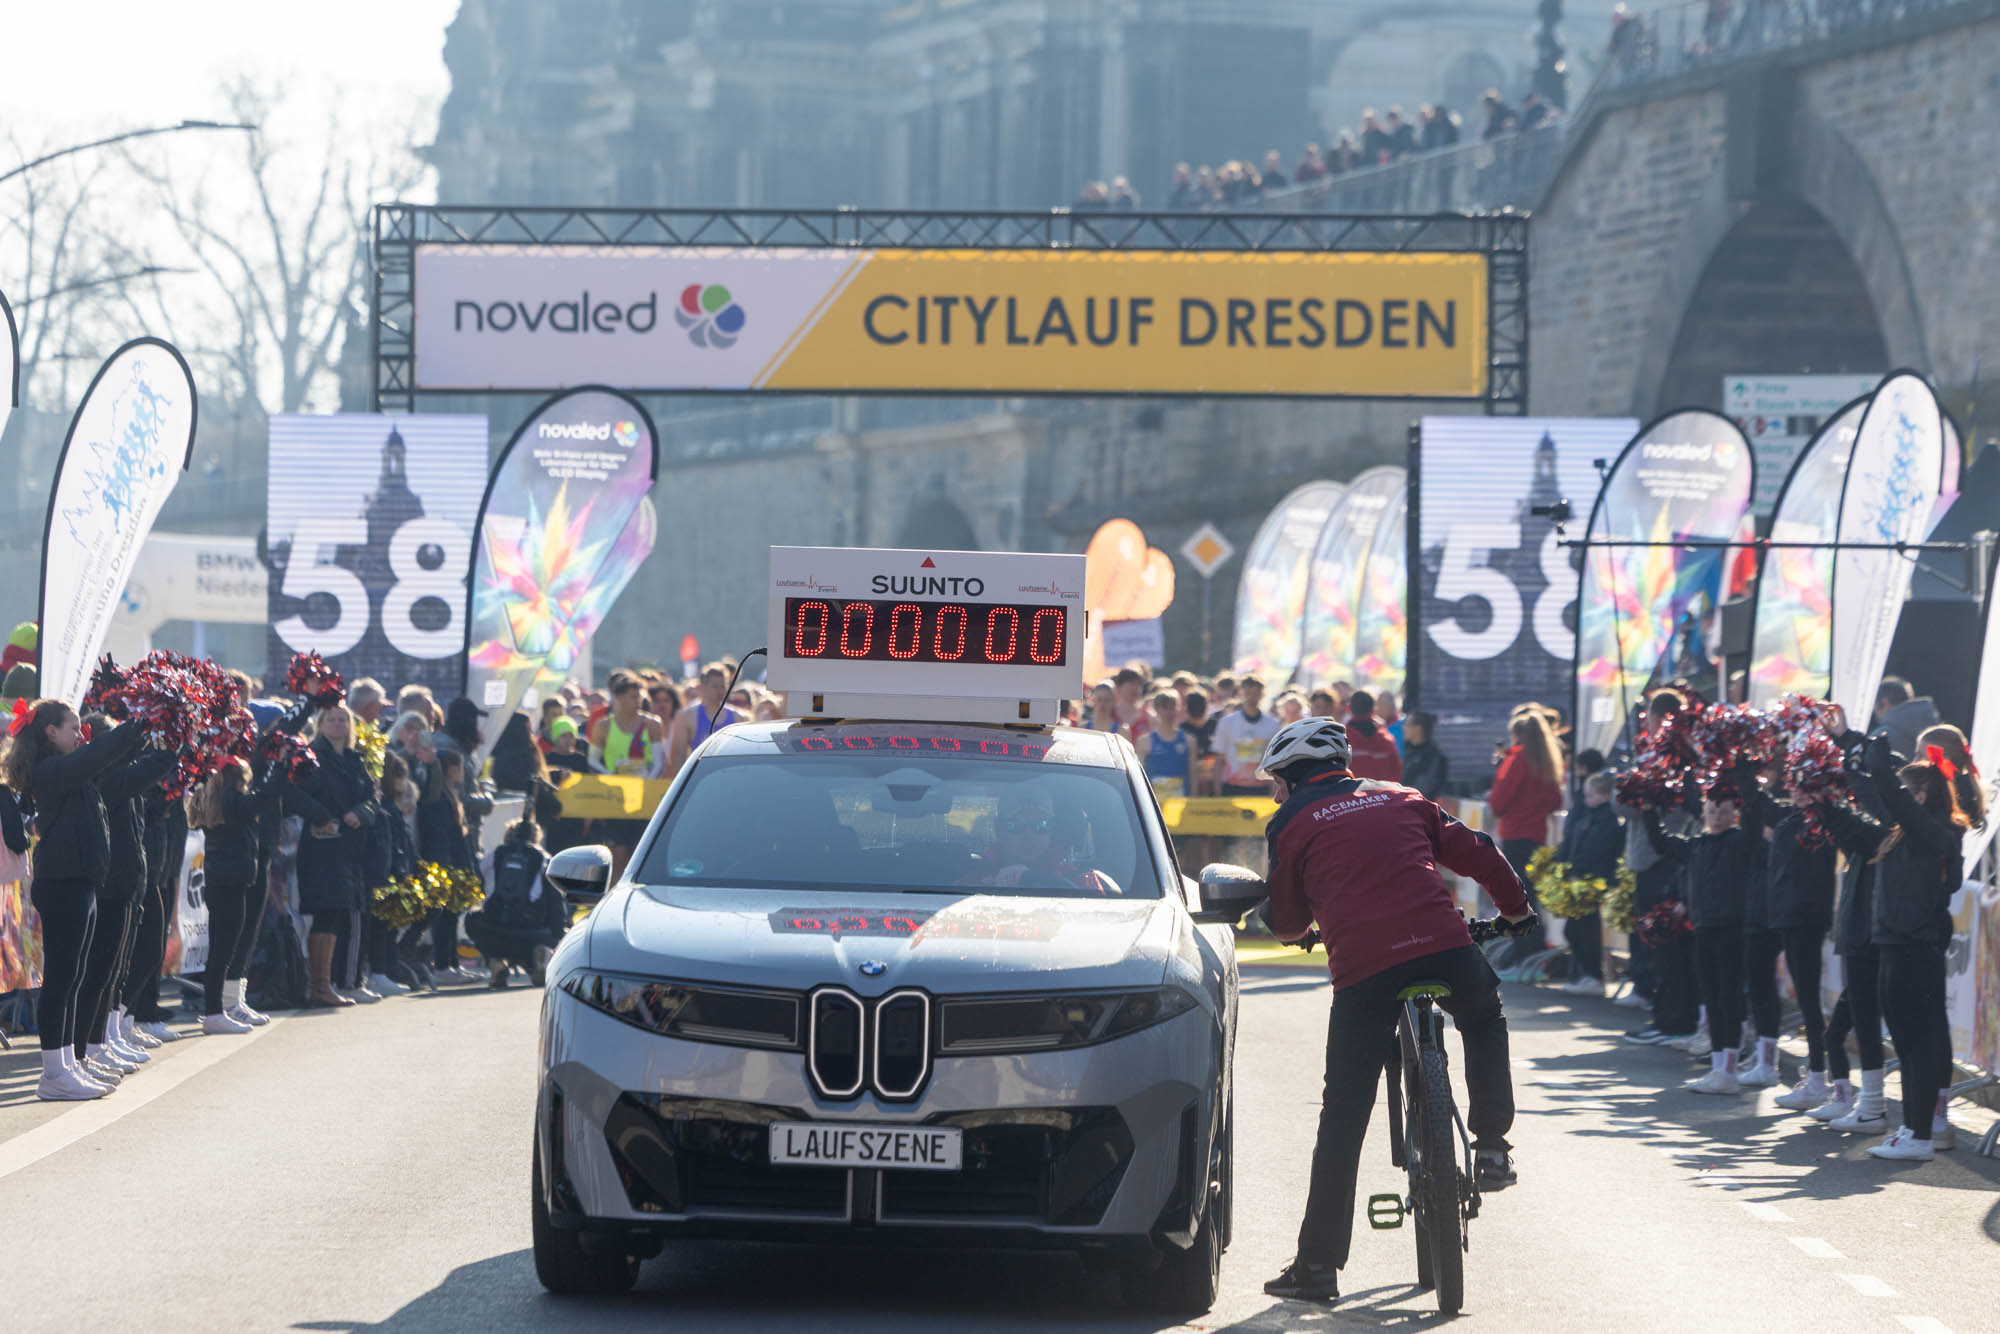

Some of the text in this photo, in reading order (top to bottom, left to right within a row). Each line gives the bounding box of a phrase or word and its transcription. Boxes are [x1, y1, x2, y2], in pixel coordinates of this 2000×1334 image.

[455, 291, 657, 334] novaled
[863, 293, 1458, 349] CITYLAUF DRESDEN
[539, 421, 611, 441] novaled
[197, 553, 255, 571] BMW
[273, 518, 471, 660] 58
[871, 575, 985, 597] SUUNTO
[1312, 794, 1390, 821] RACEMAKER
[786, 1128, 947, 1164] LAUFSZENE
